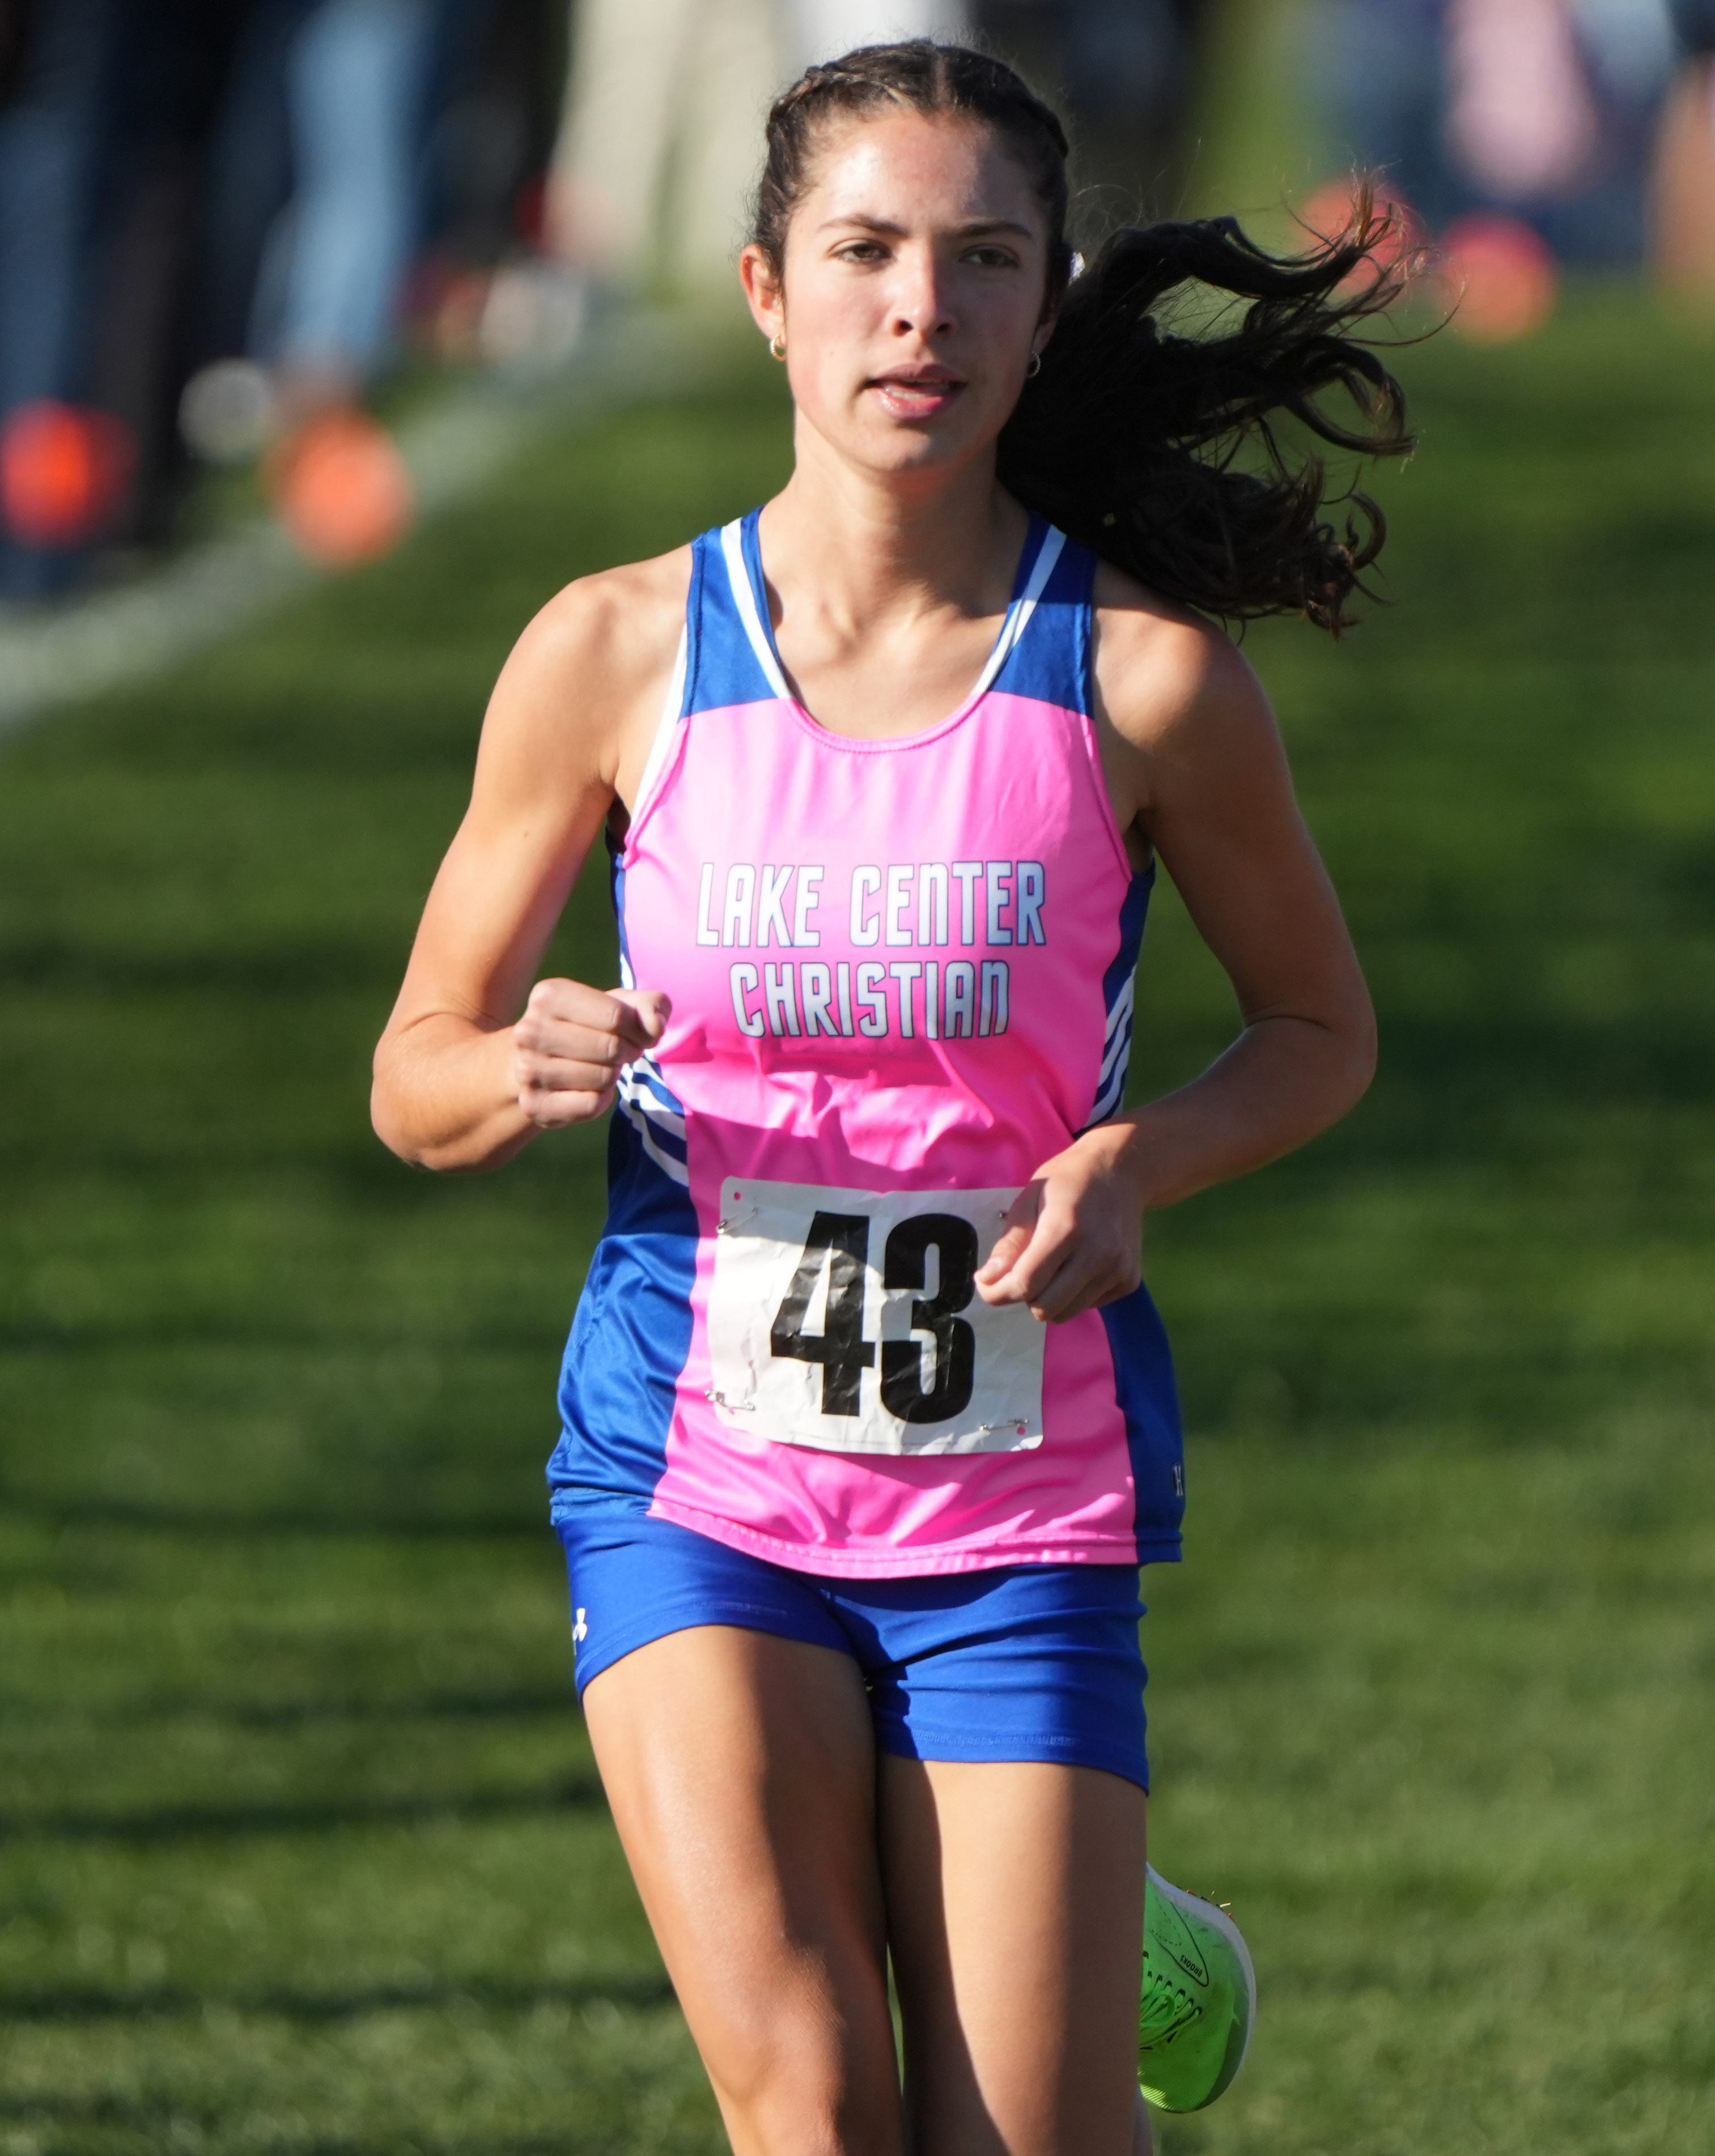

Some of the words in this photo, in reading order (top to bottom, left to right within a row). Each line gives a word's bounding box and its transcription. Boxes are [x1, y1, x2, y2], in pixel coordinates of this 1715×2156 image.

[696, 862, 825, 948] LAKE
[849, 860, 1047, 948] CENTER
[729, 959, 1010, 1040] CHRISTIAN
[770, 1210, 979, 1424] 43
[1180, 1954, 1203, 1977] BROOKS
